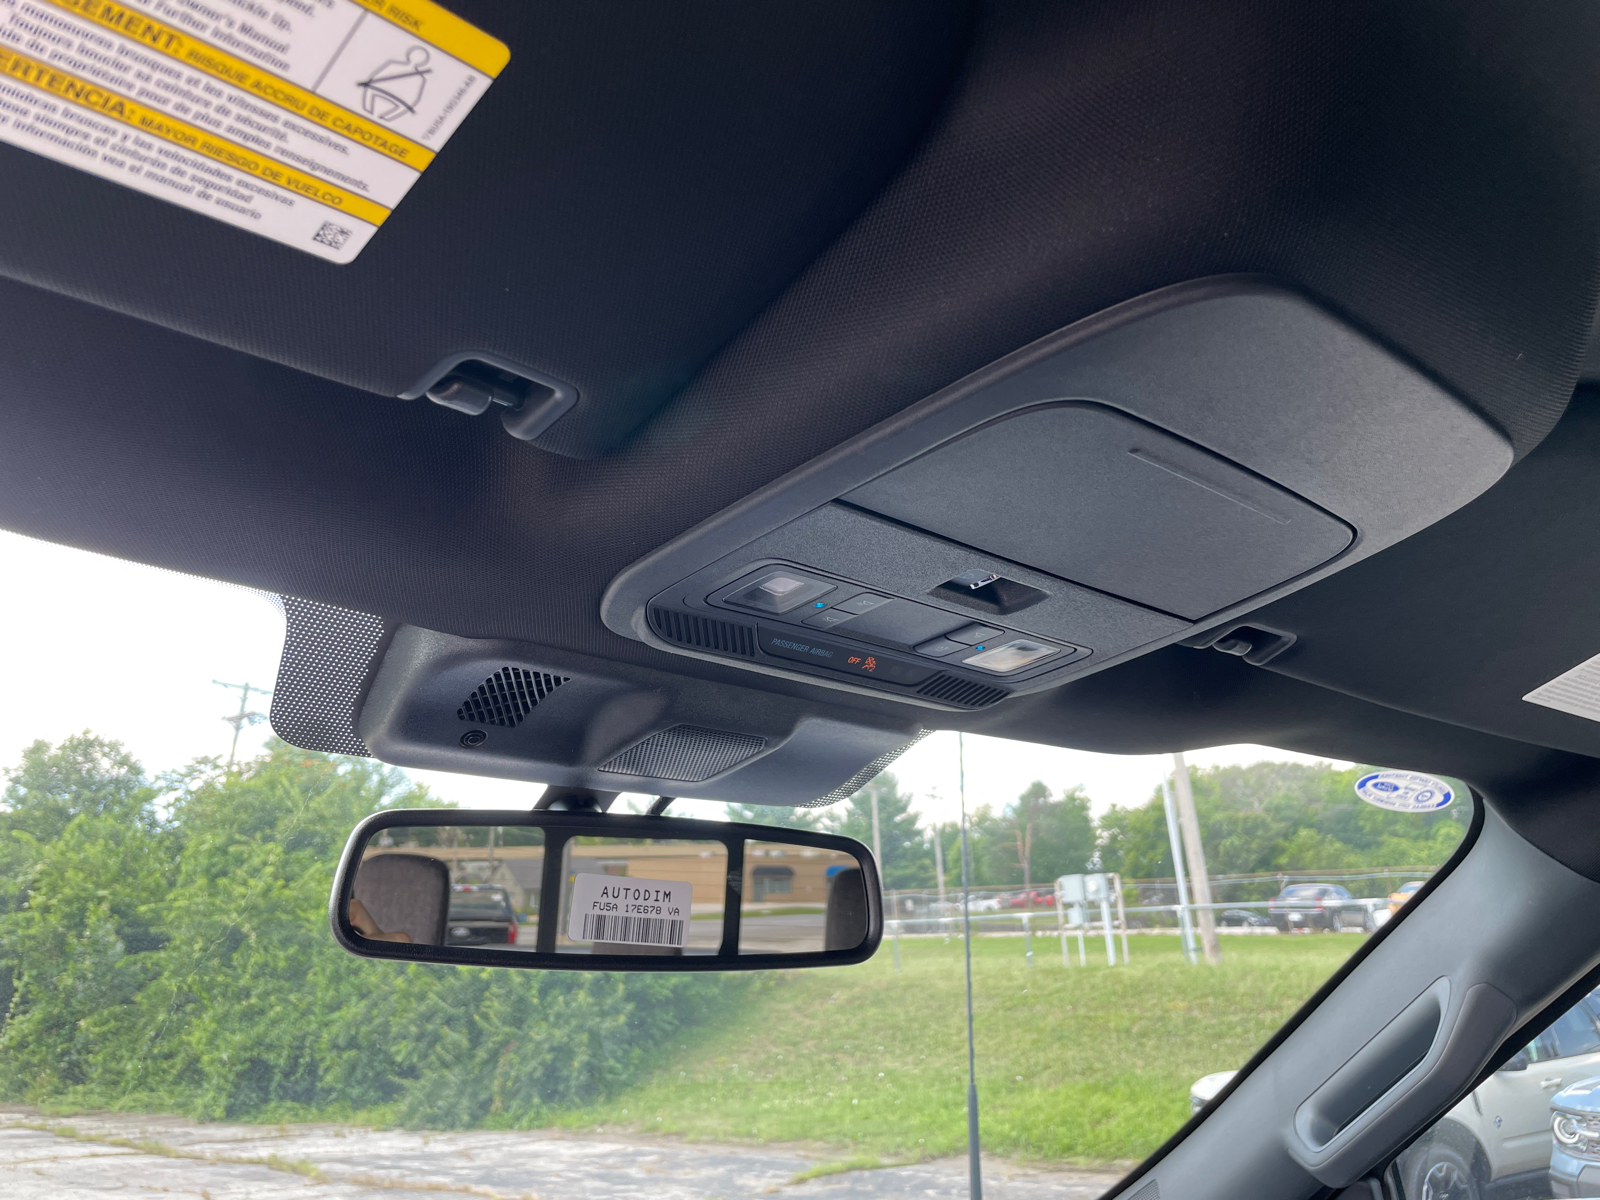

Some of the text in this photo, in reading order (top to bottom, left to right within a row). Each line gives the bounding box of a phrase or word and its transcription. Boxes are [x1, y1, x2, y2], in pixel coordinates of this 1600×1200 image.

[383, 2, 426, 32] RISK
[185, 48, 250, 85] RISQUE
[249, 78, 307, 111] ACCRU
[306, 105, 331, 122] DE
[329, 116, 410, 158] CAPOTAGE
[137, 115, 199, 146] MAYOR
[198, 140, 260, 172] RIESGO
[259, 165, 284, 181] DE
[283, 176, 345, 206] VUELCO
[771, 638, 834, 659] PASSENGER AIRBAG
[848, 656, 861, 665] OFF
[600, 886, 672, 903] AUTODIM
[592, 901, 680, 917] FU5A 17E678 VA
